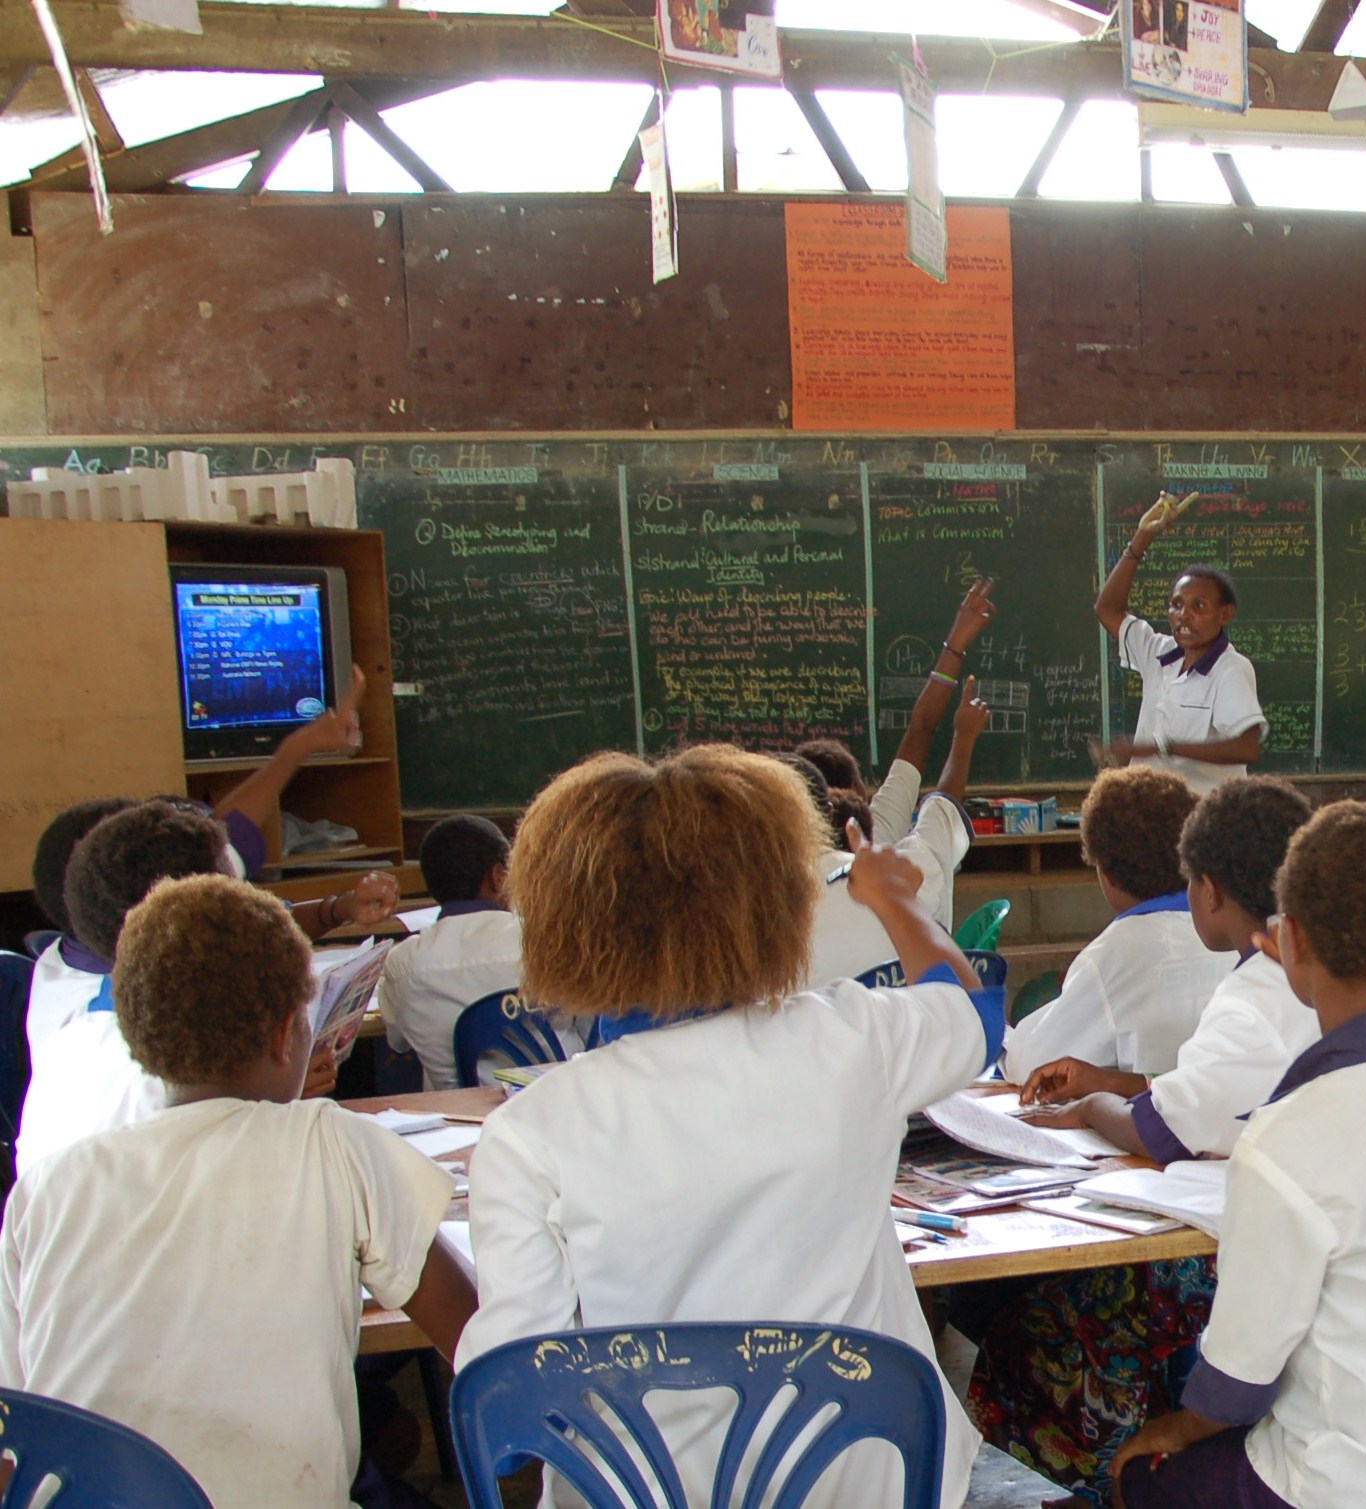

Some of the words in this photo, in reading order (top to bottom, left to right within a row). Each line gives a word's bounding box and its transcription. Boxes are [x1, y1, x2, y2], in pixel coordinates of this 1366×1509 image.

[1201, 10, 1220, 25] JOY
[63, 448, 102, 474] Aa
[252, 446, 292, 472] Dd
[359, 444, 390, 470] Ff
[457, 444, 493, 468] Hh
[823, 441, 855, 465] Nn
[439, 469, 537, 483] MATHEMATICS
[717, 465, 776, 478] SCIENCE
[925, 465, 963, 478] SOCIAL
[975, 465, 1027, 479] SCIENCE
[1164, 464, 1208, 478] MAKING
[1215, 465, 1222, 476] A
[1230, 465, 1265, 478] LIVING
[764, 548, 790, 564] and
[230, 595, 250, 605] Prime
